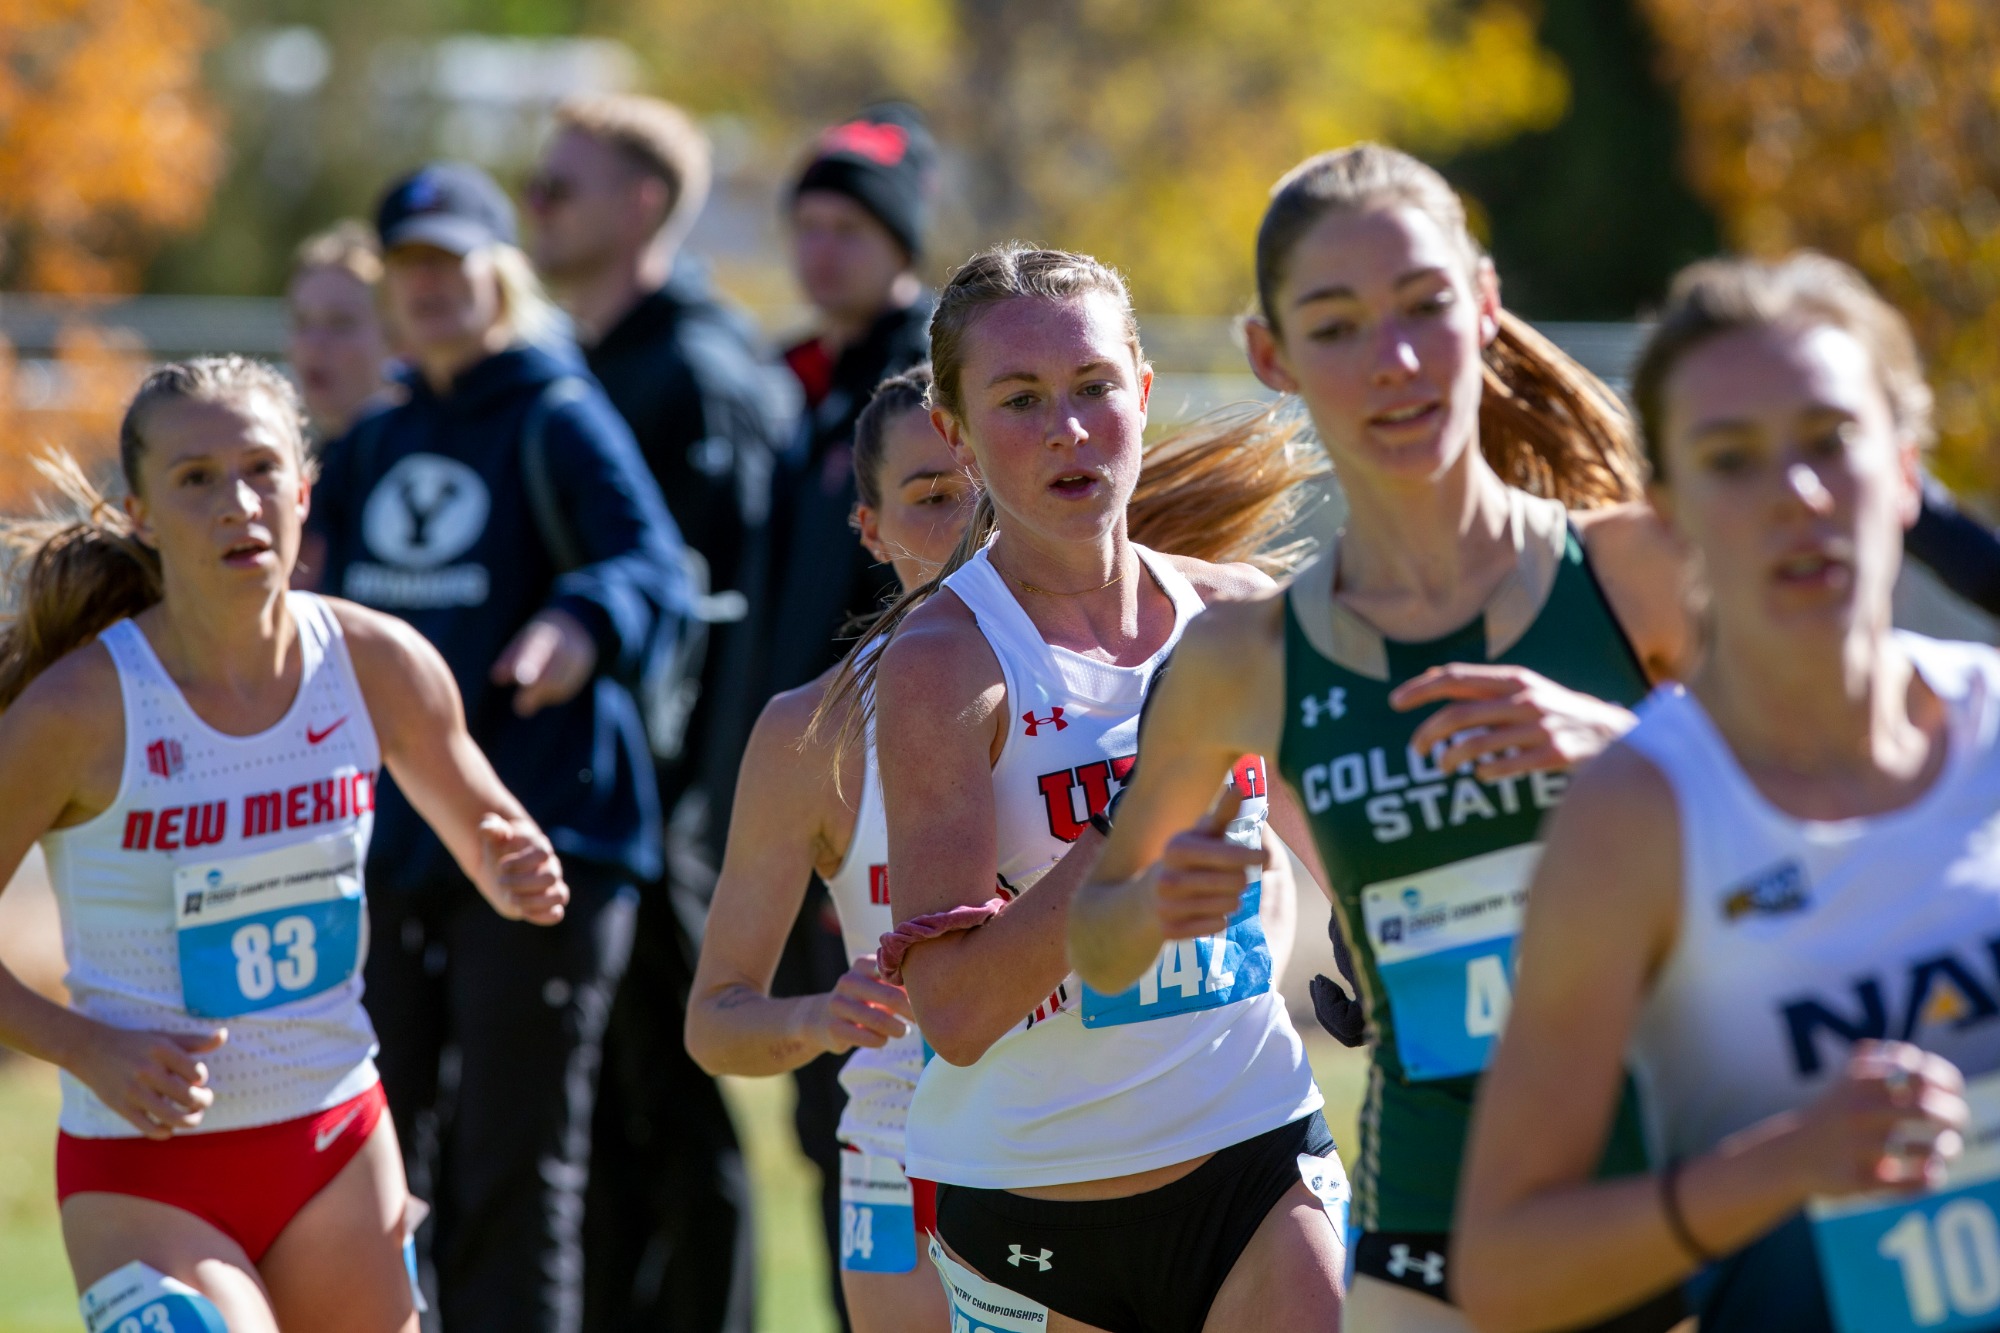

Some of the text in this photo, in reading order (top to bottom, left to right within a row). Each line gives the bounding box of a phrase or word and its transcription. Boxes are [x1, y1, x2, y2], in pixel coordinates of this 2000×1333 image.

[122, 801, 227, 851] NEW
[1366, 769, 1568, 843] STATE
[231, 915, 317, 1000] 83
[1783, 936, 2000, 1074] NA
[972, 1297, 1044, 1323] CHAMPIONSHIPS
